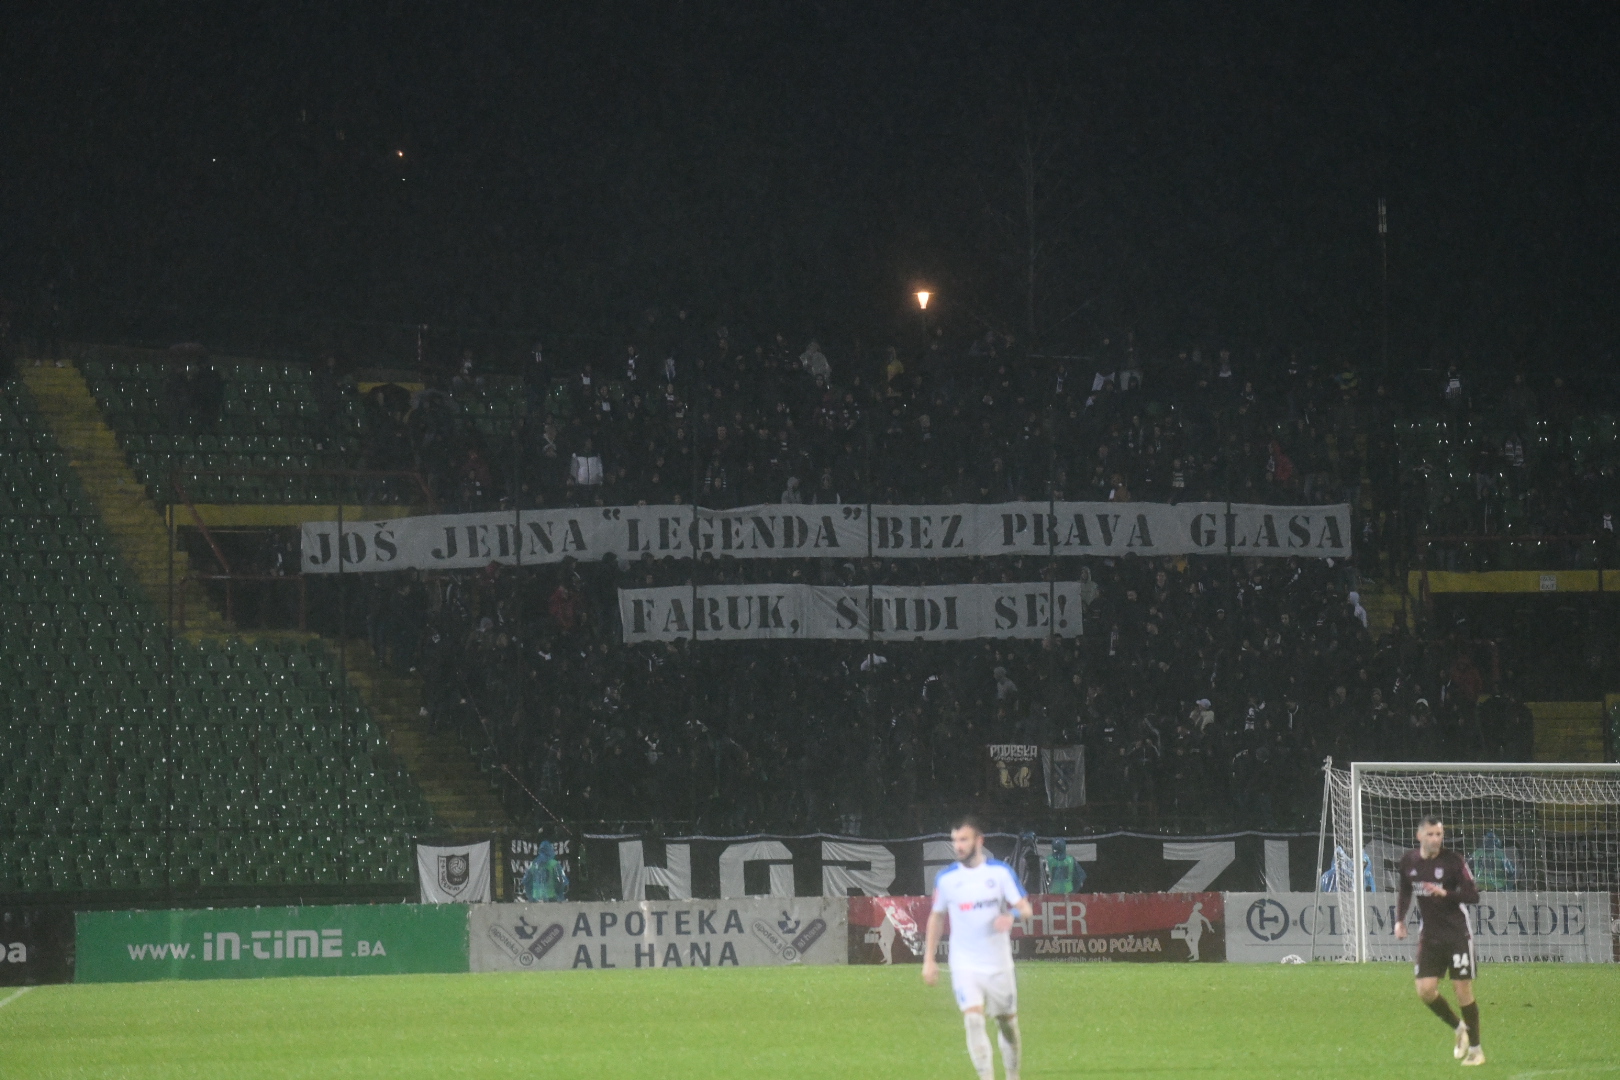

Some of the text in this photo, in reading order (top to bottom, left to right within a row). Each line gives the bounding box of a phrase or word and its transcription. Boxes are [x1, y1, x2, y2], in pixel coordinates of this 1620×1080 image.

[309, 520, 397, 566] JOŠ
[431, 517, 588, 560] JEDNA
[876, 514, 964, 549] BEZ
[1000, 512, 1154, 547] PRAVA
[1190, 512, 1344, 549] GLASA
[631, 592, 1068, 635] FARUK, STIDI SE!
[571, 910, 745, 938] APOTEKA
[754, 921, 783, 950] apoteka
[572, 941, 740, 969] AL HANA
[1035, 935, 1087, 954] ZAŠTITA
[1088, 939, 1107, 953] OD
[1110, 934, 1162, 953] POŽARA
[1452, 952, 1470, 969] 24
